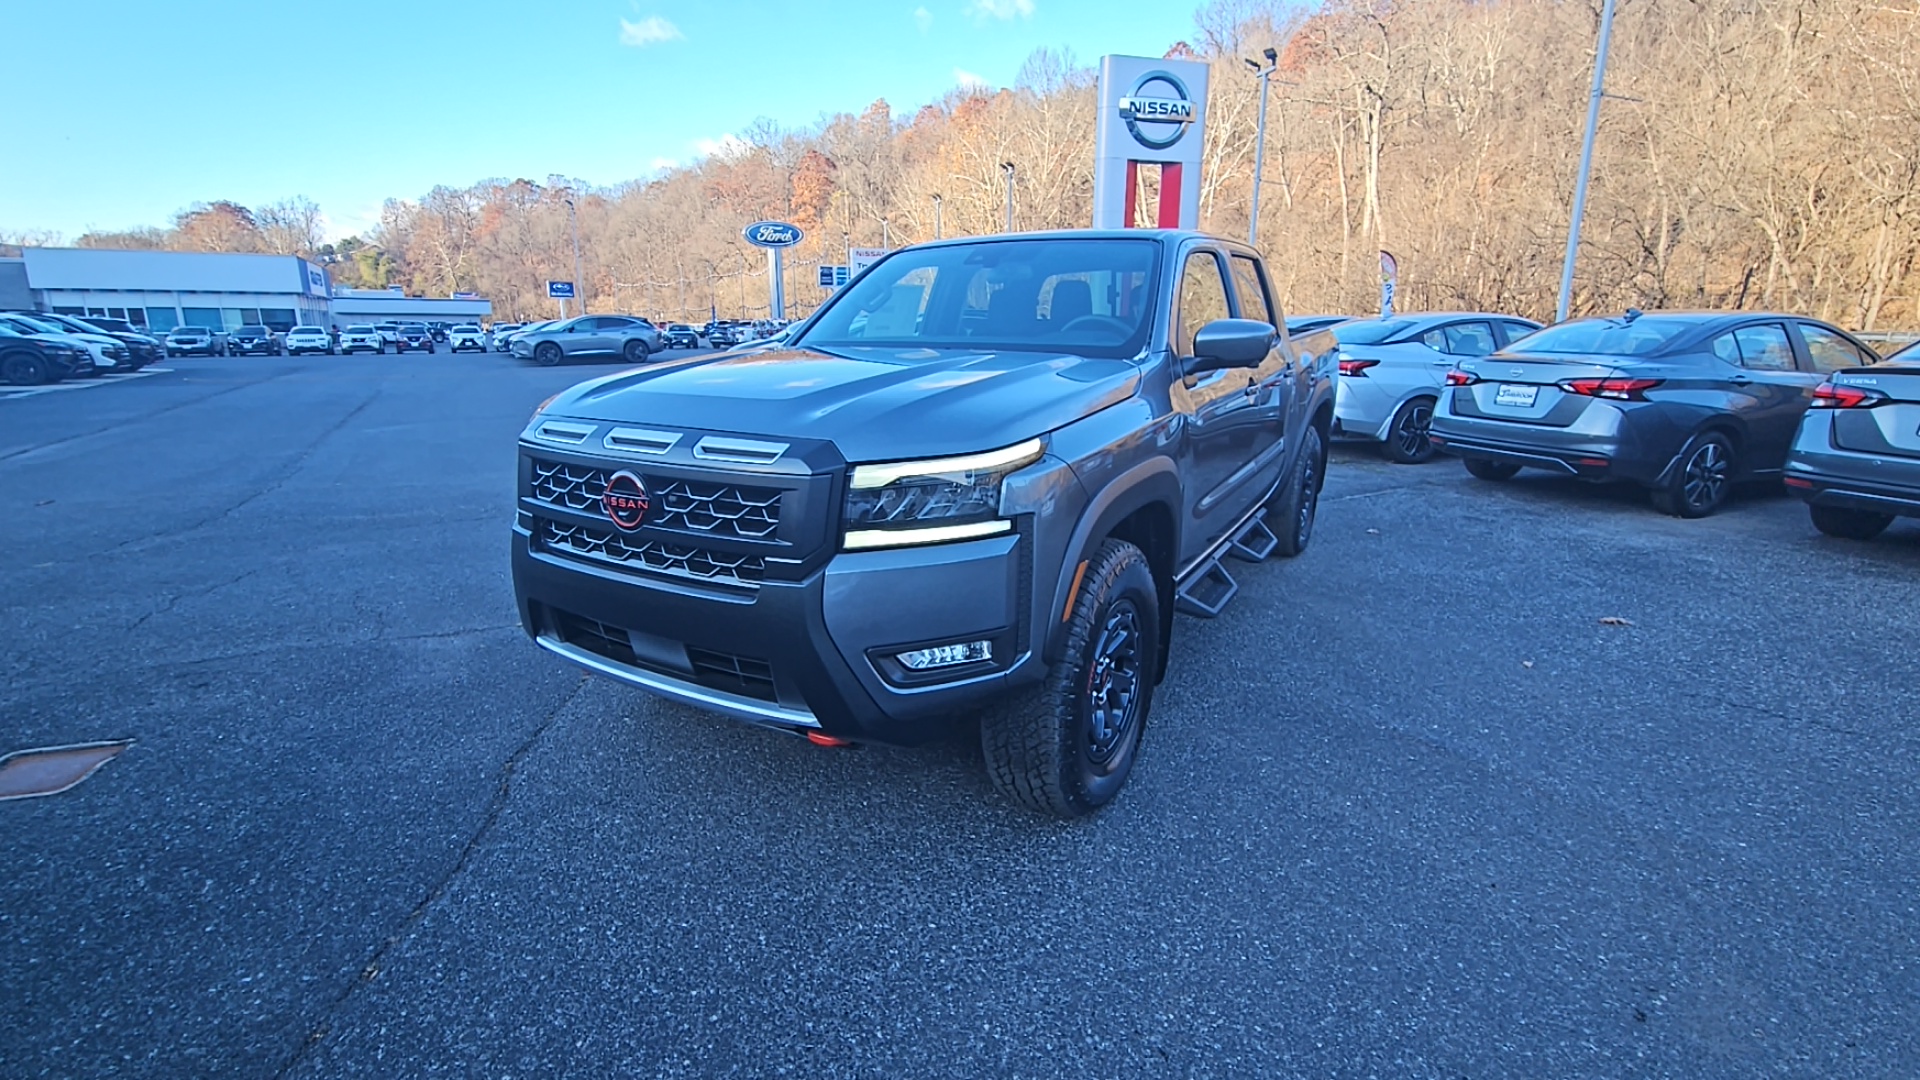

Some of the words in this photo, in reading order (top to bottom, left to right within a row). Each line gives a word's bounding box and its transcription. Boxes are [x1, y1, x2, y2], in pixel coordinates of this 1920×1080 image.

[1128, 100, 1191, 117] NISSAN
[757, 226, 793, 242] Ford
[603, 494, 648, 509] NISSAN
